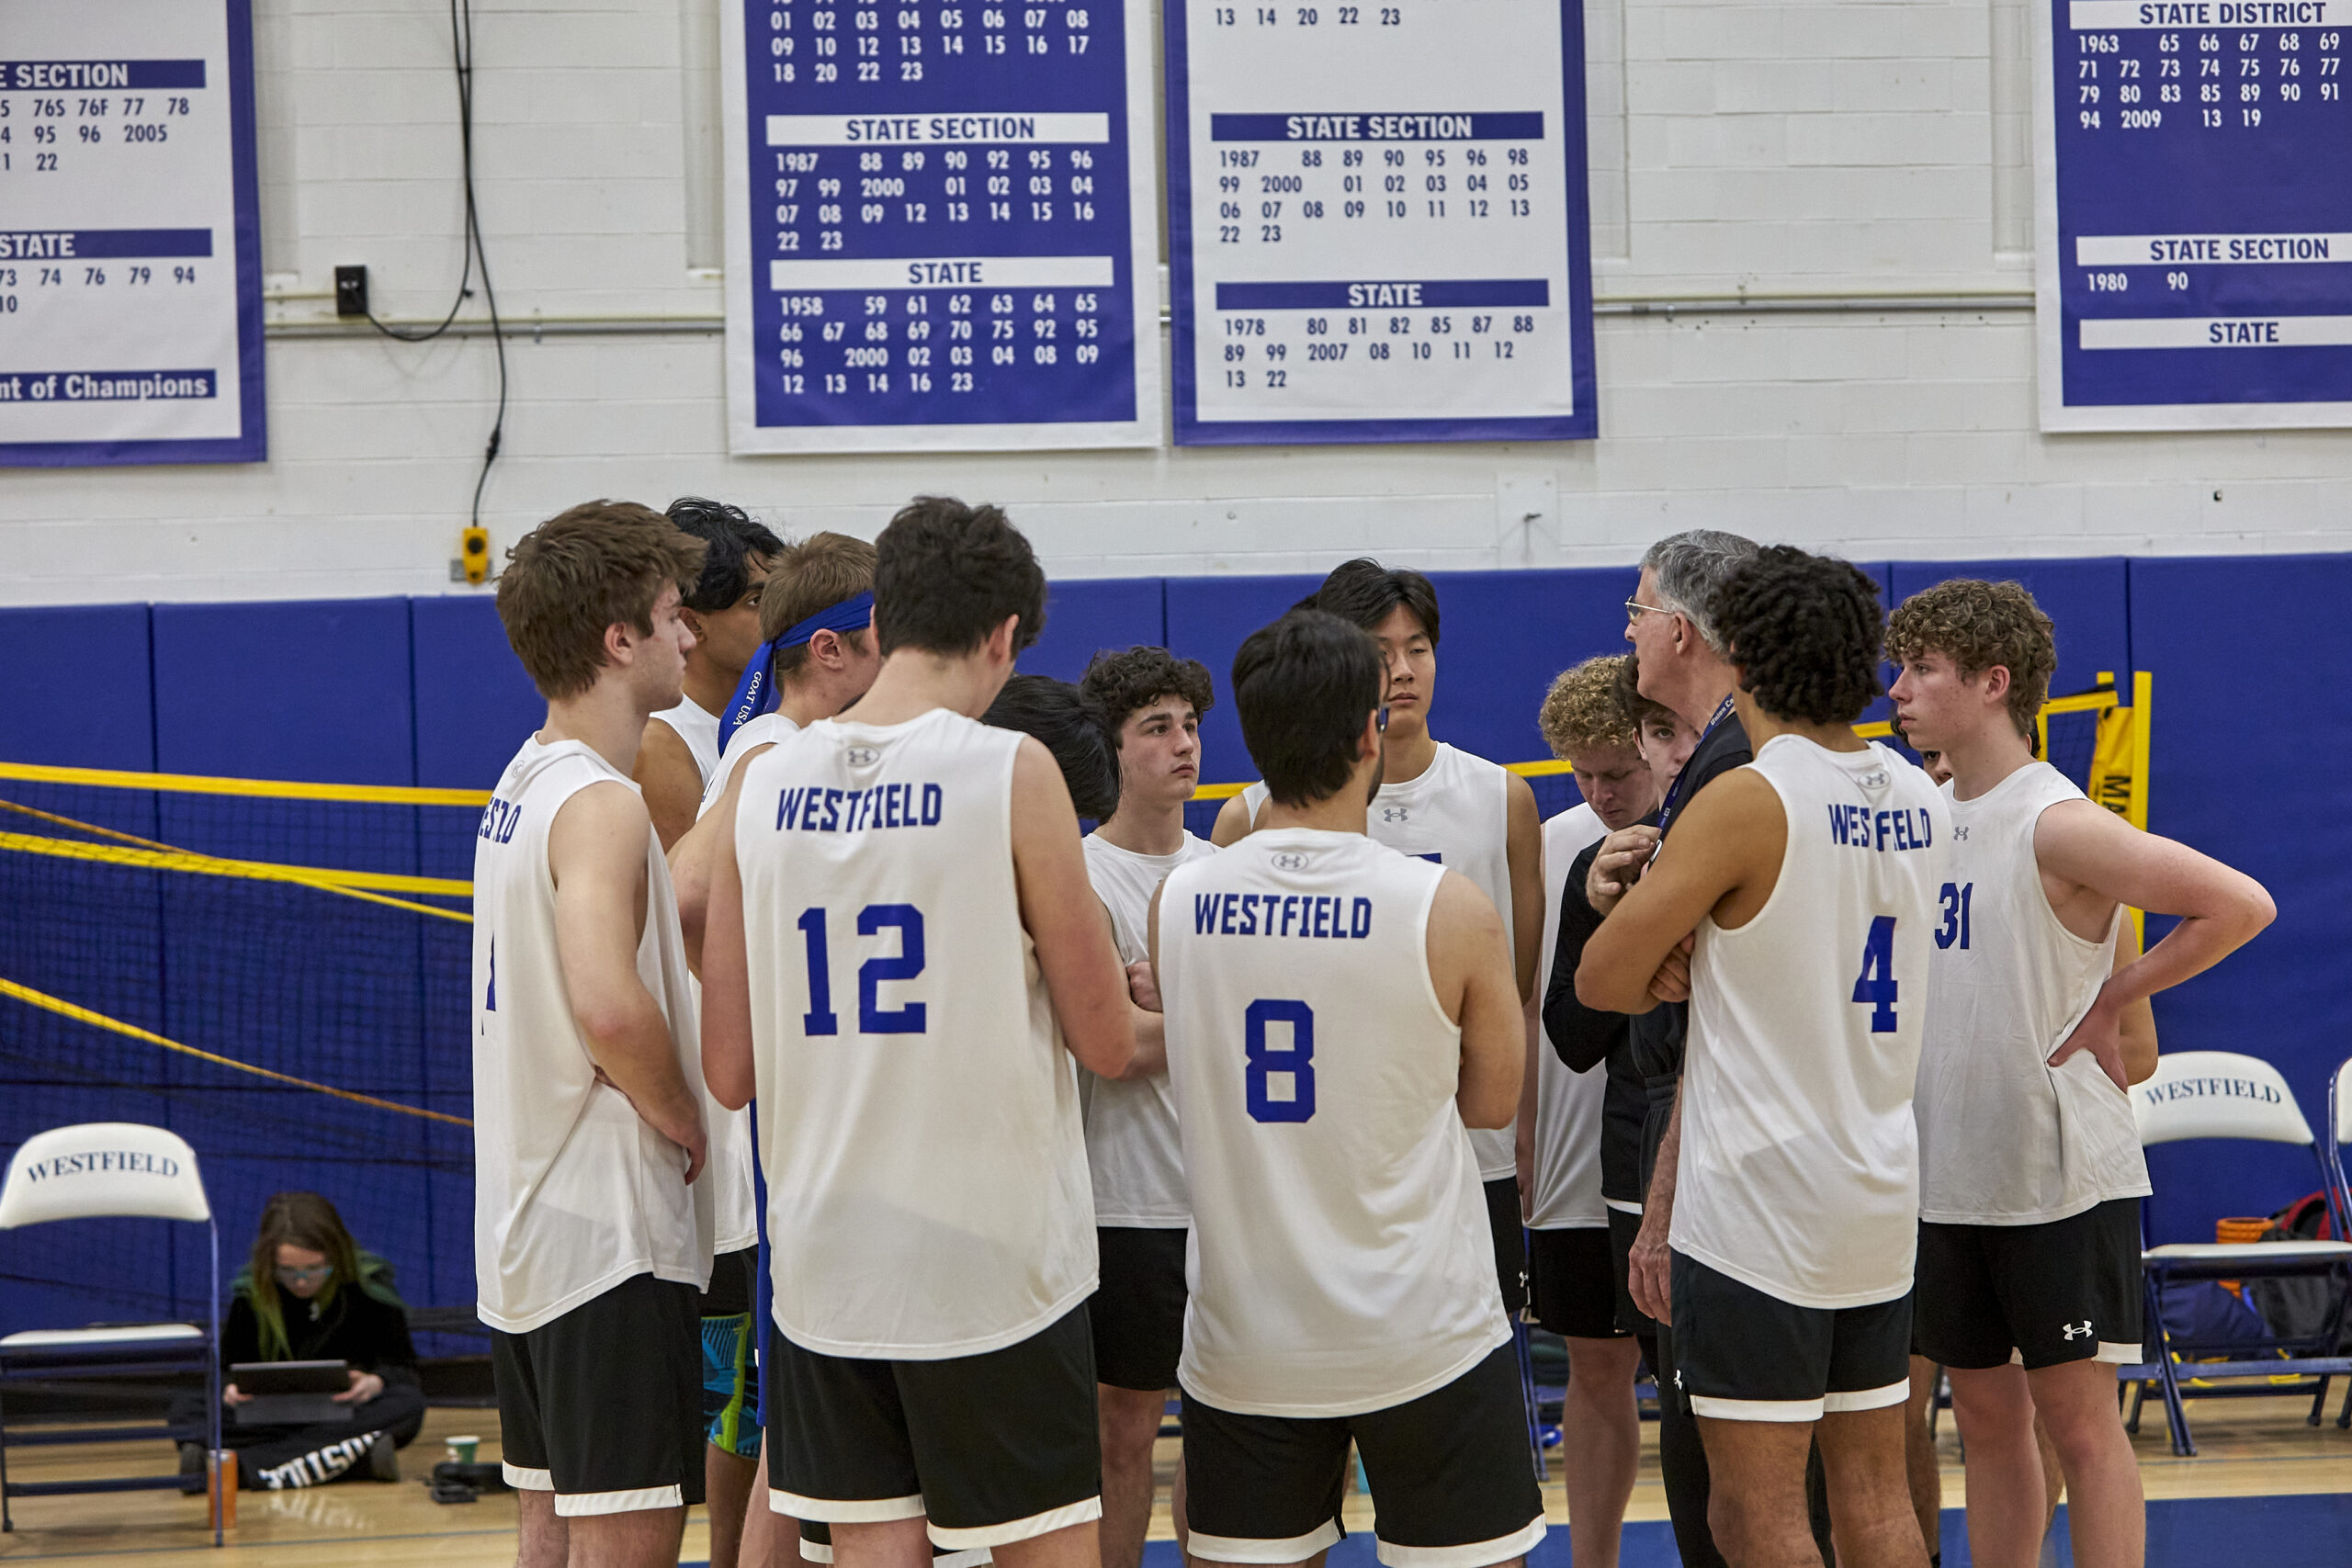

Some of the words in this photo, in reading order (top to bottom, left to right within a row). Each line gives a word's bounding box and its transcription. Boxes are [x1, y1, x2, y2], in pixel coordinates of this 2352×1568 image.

[770, 11, 791, 30] 01
[812, 11, 836, 30] 02
[855, 10, 878, 30] 03
[898, 10, 921, 29] 04
[940, 9, 963, 29] 05
[982, 8, 1005, 28] 06
[1024, 9, 1047, 28] 07
[1066, 9, 1090, 29] 08
[1216, 7, 1236, 26] 13
[1257, 7, 1276, 26] 14
[1297, 7, 1318, 26] 20
[1338, 6, 1359, 25] 22
[1380, 7, 1401, 26] 23
[2139, 3, 2211, 26] STATE
[2219, 2, 2326, 24] DISTRICT
[2079, 34, 2120, 53] 1963
[2159, 33, 2179, 52] 65
[2199, 33, 2220, 51] 66
[2239, 33, 2260, 51] 67
[2278, 33, 2301, 51] 68
[2319, 32, 2340, 51] 69
[16, 63, 129, 87] SECTION
[774, 62, 796, 83] 18
[814, 62, 838, 83] 20
[857, 61, 880, 82] 22
[900, 61, 923, 81] 23
[2079, 60, 2098, 79] 71
[2120, 59, 2141, 78] 72
[2160, 59, 2181, 77] 73
[2199, 59, 2221, 77] 74
[2240, 58, 2260, 77] 75
[2280, 58, 2301, 76] 76
[2320, 57, 2341, 75] 77
[2080, 85, 2100, 104] 79
[2120, 85, 2141, 104] 80
[2160, 84, 2181, 103] 83
[2199, 84, 2222, 103] 85
[2240, 83, 2261, 102] 89
[2280, 83, 2301, 102] 90
[2320, 83, 2339, 101] 91
[33, 98, 66, 118] 76S
[78, 97, 108, 117] 76F
[123, 97, 145, 116] 77
[168, 97, 189, 116] 78
[33, 125, 56, 144] 95
[78, 125, 101, 143] 96
[123, 123, 167, 143] 2005
[846, 118, 921, 141] STATE
[930, 117, 1035, 140] SECTION
[1286, 116, 1362, 140] STATE
[1368, 115, 1472, 139] SECTION
[36, 152, 58, 172] 22
[776, 152, 819, 173] 1987
[860, 152, 883, 172] 88
[902, 151, 925, 171] 89
[944, 151, 968, 170] 90
[987, 150, 1010, 170] 92
[1028, 150, 1051, 170] 95
[1069, 150, 1093, 169] 96
[1220, 150, 1260, 168] 1987
[1301, 149, 1323, 167] 88
[1342, 149, 1363, 167] 89
[1384, 149, 1405, 167] 90
[1424, 149, 1446, 167] 95
[1466, 149, 1487, 167] 96
[1507, 148, 1529, 166] 98
[775, 178, 798, 197] 97
[818, 178, 842, 197] 99
[860, 177, 905, 197] 2000
[944, 176, 966, 197] 01
[987, 175, 1011, 196] 02
[1029, 175, 1053, 196] 03
[1071, 175, 1093, 195] 04
[1219, 175, 1240, 193] 99
[1261, 175, 1303, 193] 2000
[1343, 175, 1362, 193] 01
[1384, 175, 1406, 193] 02
[1425, 175, 1447, 193] 03
[1466, 174, 1487, 192] 04
[1508, 173, 1529, 191] 05
[0, 233, 75, 257] STATE
[777, 231, 799, 251] 22
[820, 230, 843, 251] 23
[1219, 225, 1240, 243] 22
[1261, 224, 1282, 243] 23
[2150, 239, 2222, 262] STATE
[2229, 238, 2329, 261] SECTION
[40, 268, 62, 287] 74
[85, 266, 106, 286] 76
[130, 266, 152, 285] 79
[173, 266, 195, 284] 94
[908, 262, 983, 285] STATE
[2087, 272, 2128, 292] 1980
[2166, 271, 2188, 290] 90
[781, 296, 824, 316] 1958
[865, 296, 888, 316] 59
[906, 295, 928, 315] 61
[948, 294, 972, 314] 62
[990, 294, 1014, 314] 63
[1033, 293, 1056, 313] 64
[1075, 293, 1098, 312] 65
[1348, 283, 1423, 307] STATE
[1226, 318, 1266, 336] 1978
[1306, 317, 1328, 336] 80
[1348, 317, 1367, 335] 81
[1389, 316, 1410, 334] 82
[1430, 316, 1452, 334] 85
[1472, 315, 1492, 334] 87
[1512, 314, 1534, 333] 88
[2209, 321, 2279, 344] STATE
[780, 348, 804, 368] 96
[844, 347, 888, 367] 2000
[908, 346, 932, 367] 02
[950, 345, 973, 366] 03
[991, 345, 1015, 366] 04
[1034, 344, 1057, 365] 08
[1075, 344, 1099, 364] 09
[1224, 344, 1246, 362] 89
[1266, 344, 1287, 361] 99
[1307, 343, 1349, 362] 2007
[1369, 342, 1390, 360] 08
[1412, 342, 1431, 360] 10
[1453, 341, 1470, 359] 11
[1494, 341, 1514, 359] 12
[30, 375, 57, 399] of
[65, 374, 209, 400] Champions
[783, 374, 805, 395] 12
[825, 373, 847, 393] 13
[867, 373, 889, 393] 14
[910, 372, 932, 392] 16
[951, 372, 974, 392] 23
[1227, 369, 1246, 388] 13
[1266, 369, 1286, 388] 22
[746, 671, 763, 705] GOAT
[732, 705, 752, 725] USA
[1710, 706, 1727, 726] Union
[1827, 804, 1932, 852] WESFELD
[1195, 893, 1372, 939] WESTFIELD
[1934, 882, 1973, 950] 31
[797, 903, 927, 1036] 12
[1851, 915, 1899, 1033] 4
[1245, 998, 1316, 1123] 8
[2145, 1077, 2281, 1105] WESTFIELD
[28, 1151, 179, 1182] WESTFIELD
